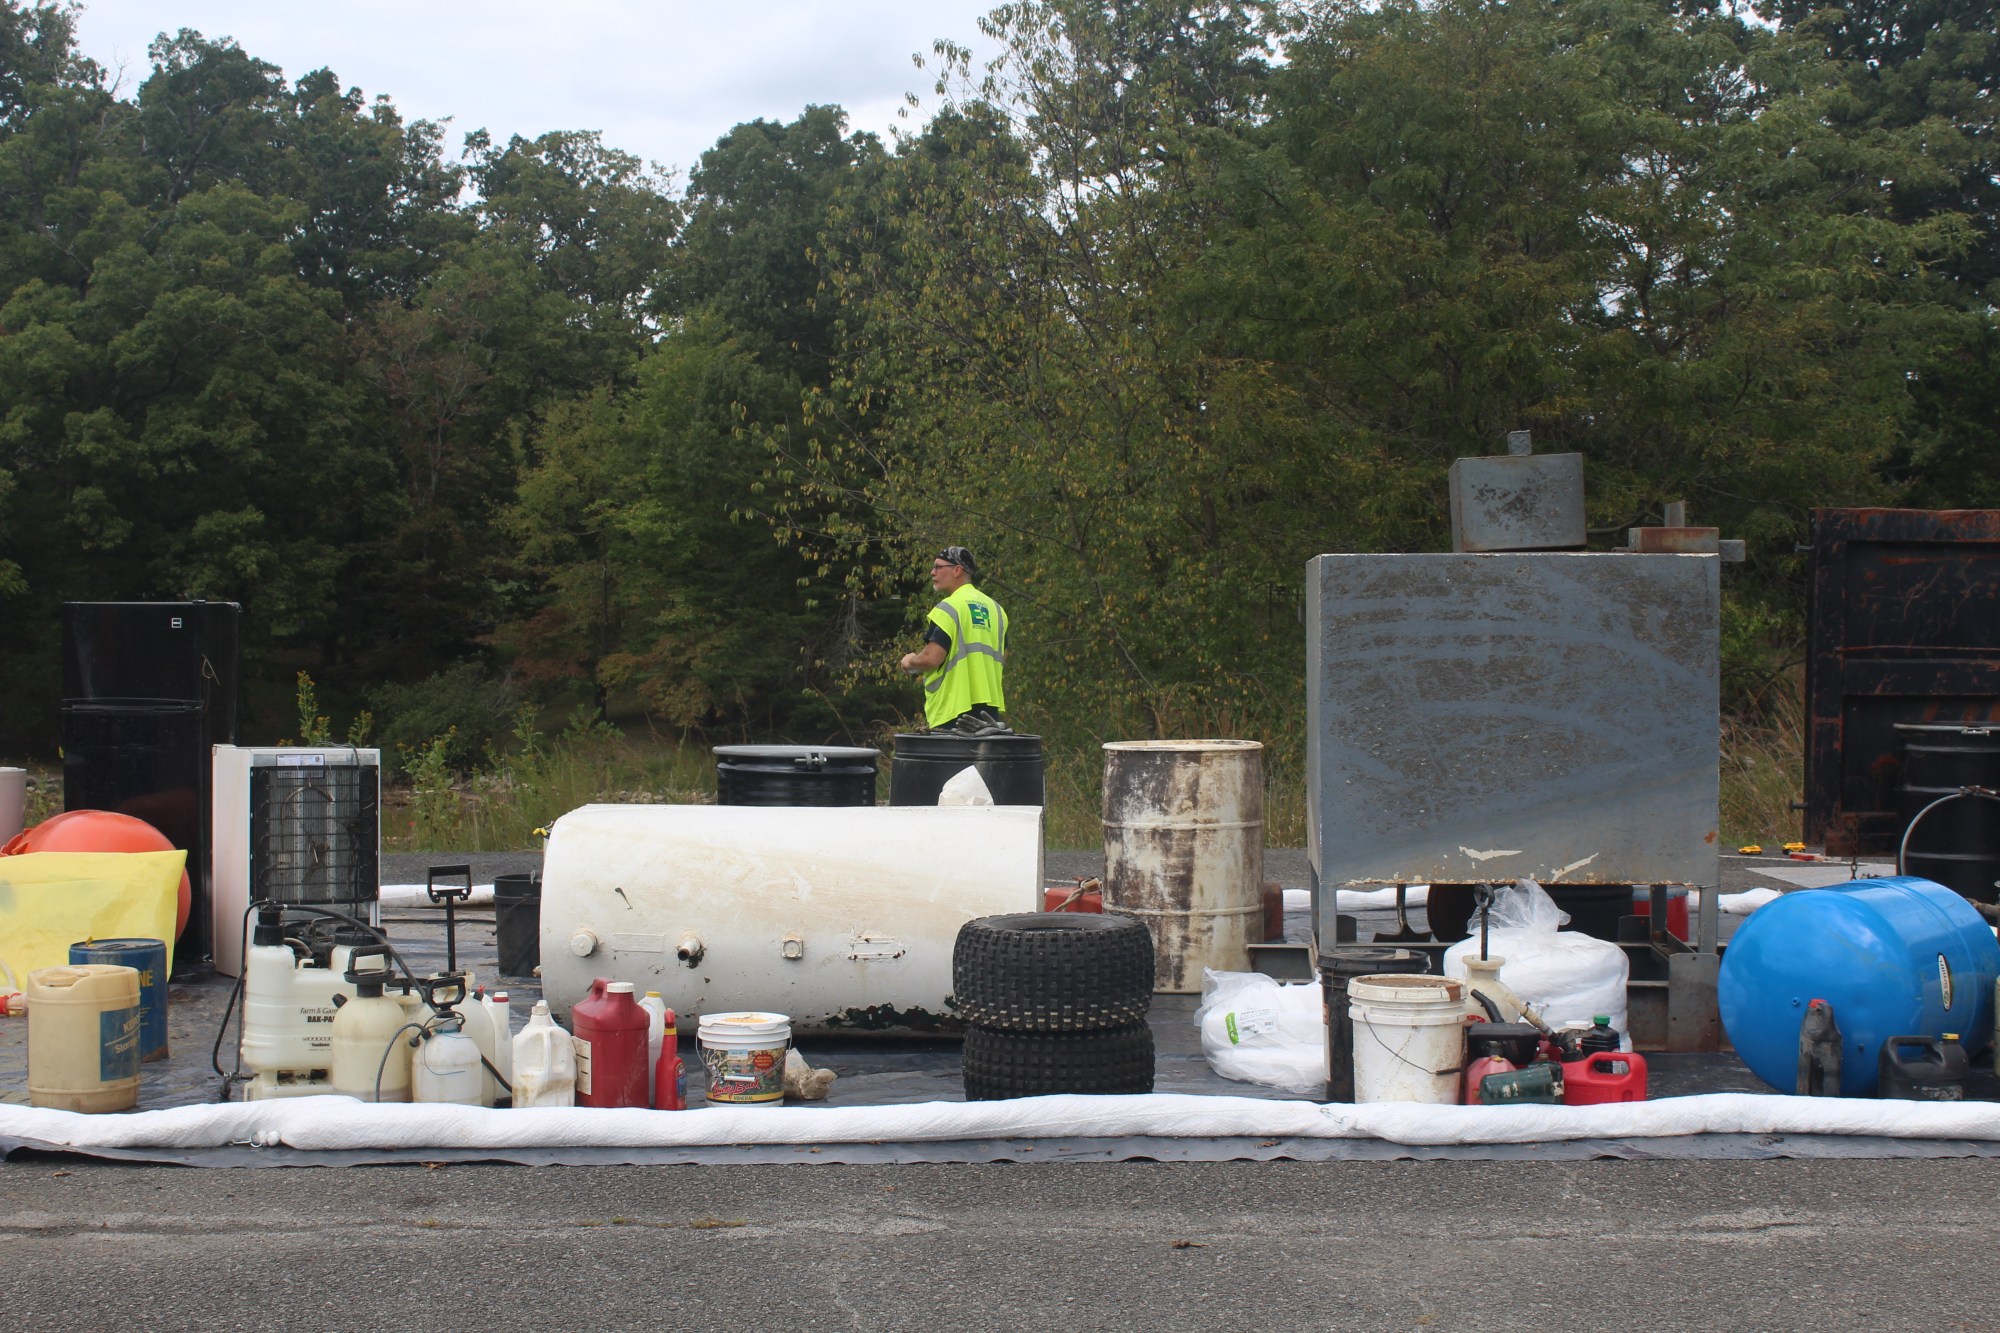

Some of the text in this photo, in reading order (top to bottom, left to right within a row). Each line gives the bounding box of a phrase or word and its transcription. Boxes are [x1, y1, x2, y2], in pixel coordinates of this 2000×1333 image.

[307, 1015, 335, 1023] BAK-PA
[712, 1078, 735, 1100] Lucky
[732, 1075, 761, 1095] Buck
